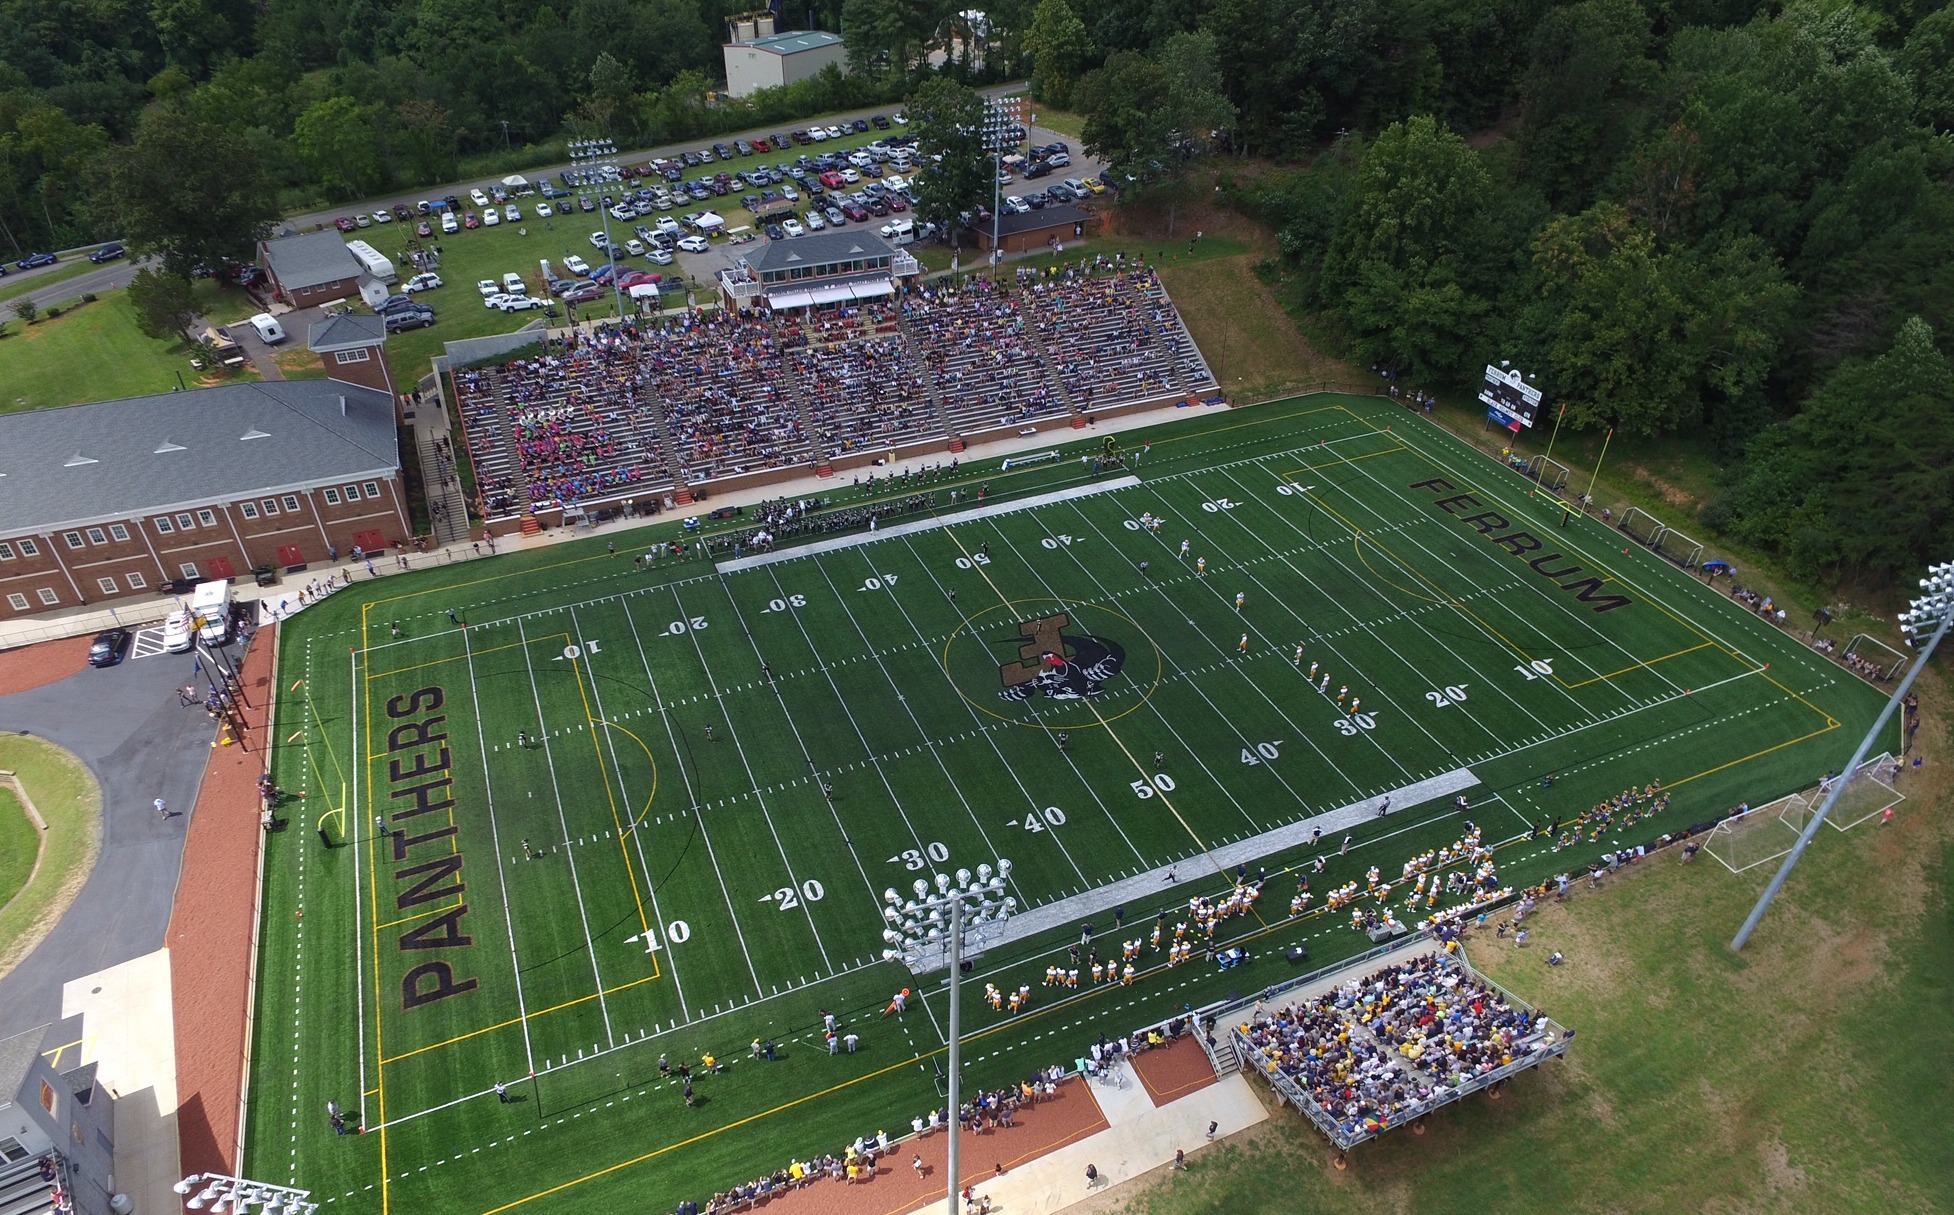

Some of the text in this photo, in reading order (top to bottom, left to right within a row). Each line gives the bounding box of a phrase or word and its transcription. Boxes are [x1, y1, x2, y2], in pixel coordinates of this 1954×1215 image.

[1488, 367, 1541, 400] FERRUM PANTHERS
[1276, 482, 1307, 496] 10
[1202, 498, 1235, 513] 20
[1041, 534, 1077, 550] 40
[1409, 477, 1633, 613] FERRUM
[955, 553, 991, 569] 50
[865, 573, 899, 591] 40
[769, 594, 807, 612] 30
[669, 615, 709, 635] 20
[564, 640, 602, 659] 10
[1513, 659, 1553, 681] 10
[1425, 686, 1468, 709] 20
[1333, 714, 1376, 737] 30
[1240, 742, 1279, 767] 40
[1130, 773, 1176, 800] 50
[1023, 806, 1067, 834] 40
[386, 684, 478, 1010] PANTHERS
[901, 841, 950, 871] 30
[774, 879, 825, 911] 20
[640, 920, 691, 953] 10
